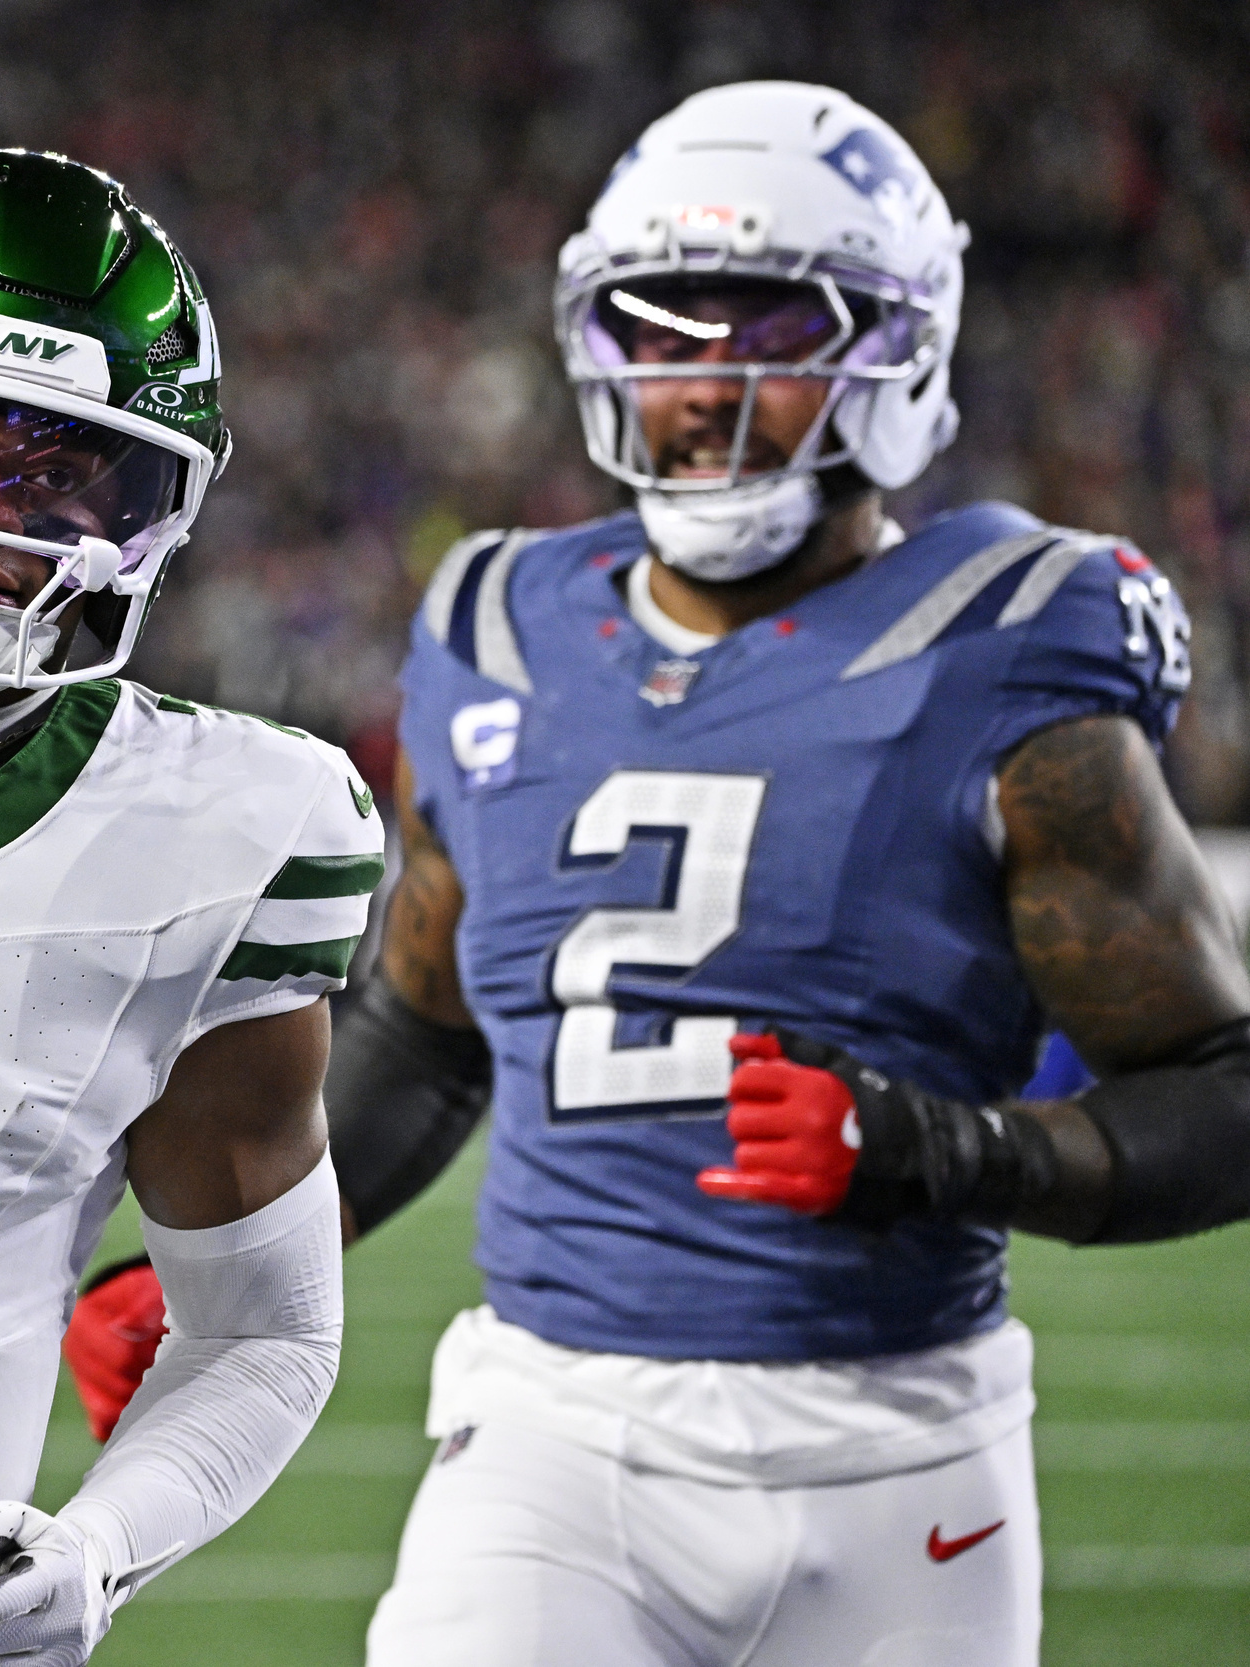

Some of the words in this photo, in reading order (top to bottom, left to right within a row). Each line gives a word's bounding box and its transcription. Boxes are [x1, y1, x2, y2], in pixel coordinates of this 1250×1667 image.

[136, 399, 185, 421] OAKLEY
[450, 697, 522, 771] C
[549, 766, 770, 1122] 2
